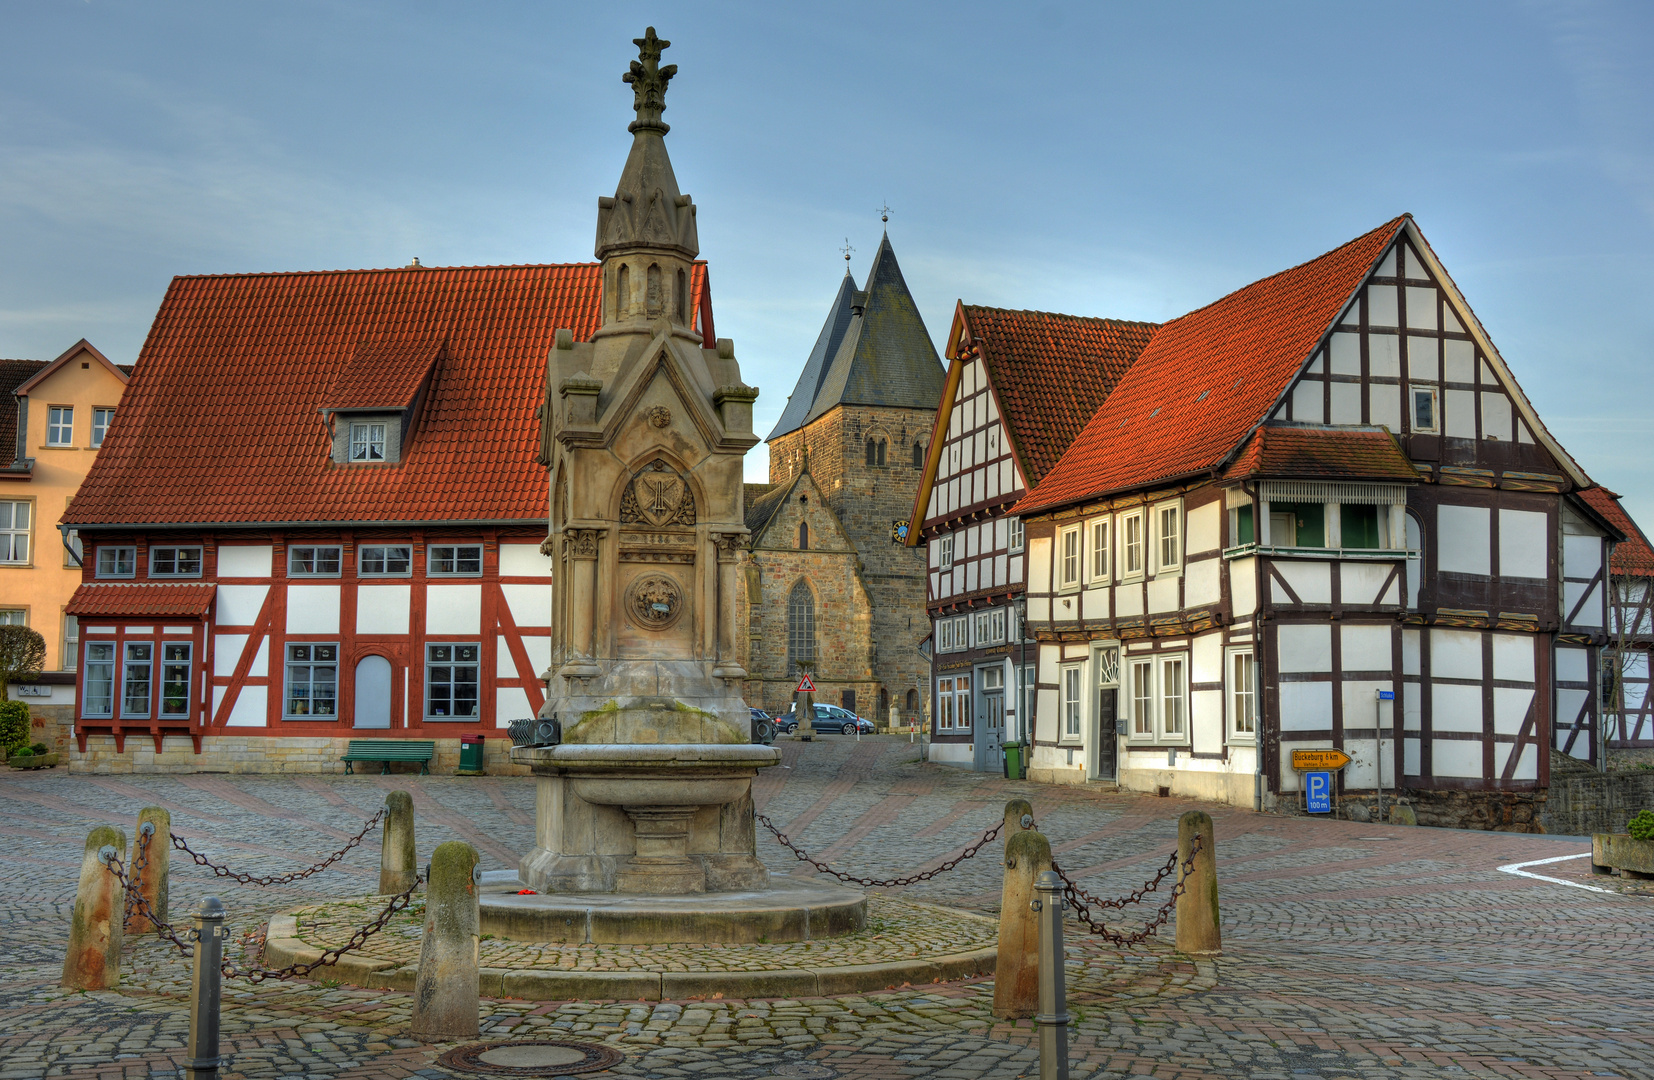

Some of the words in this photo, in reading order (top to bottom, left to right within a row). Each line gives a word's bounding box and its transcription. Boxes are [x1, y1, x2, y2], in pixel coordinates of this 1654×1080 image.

[20, 686, 28, 694] WC
[1294, 753, 1323, 762] Bückeburg
[1311, 776, 1324, 799] P
